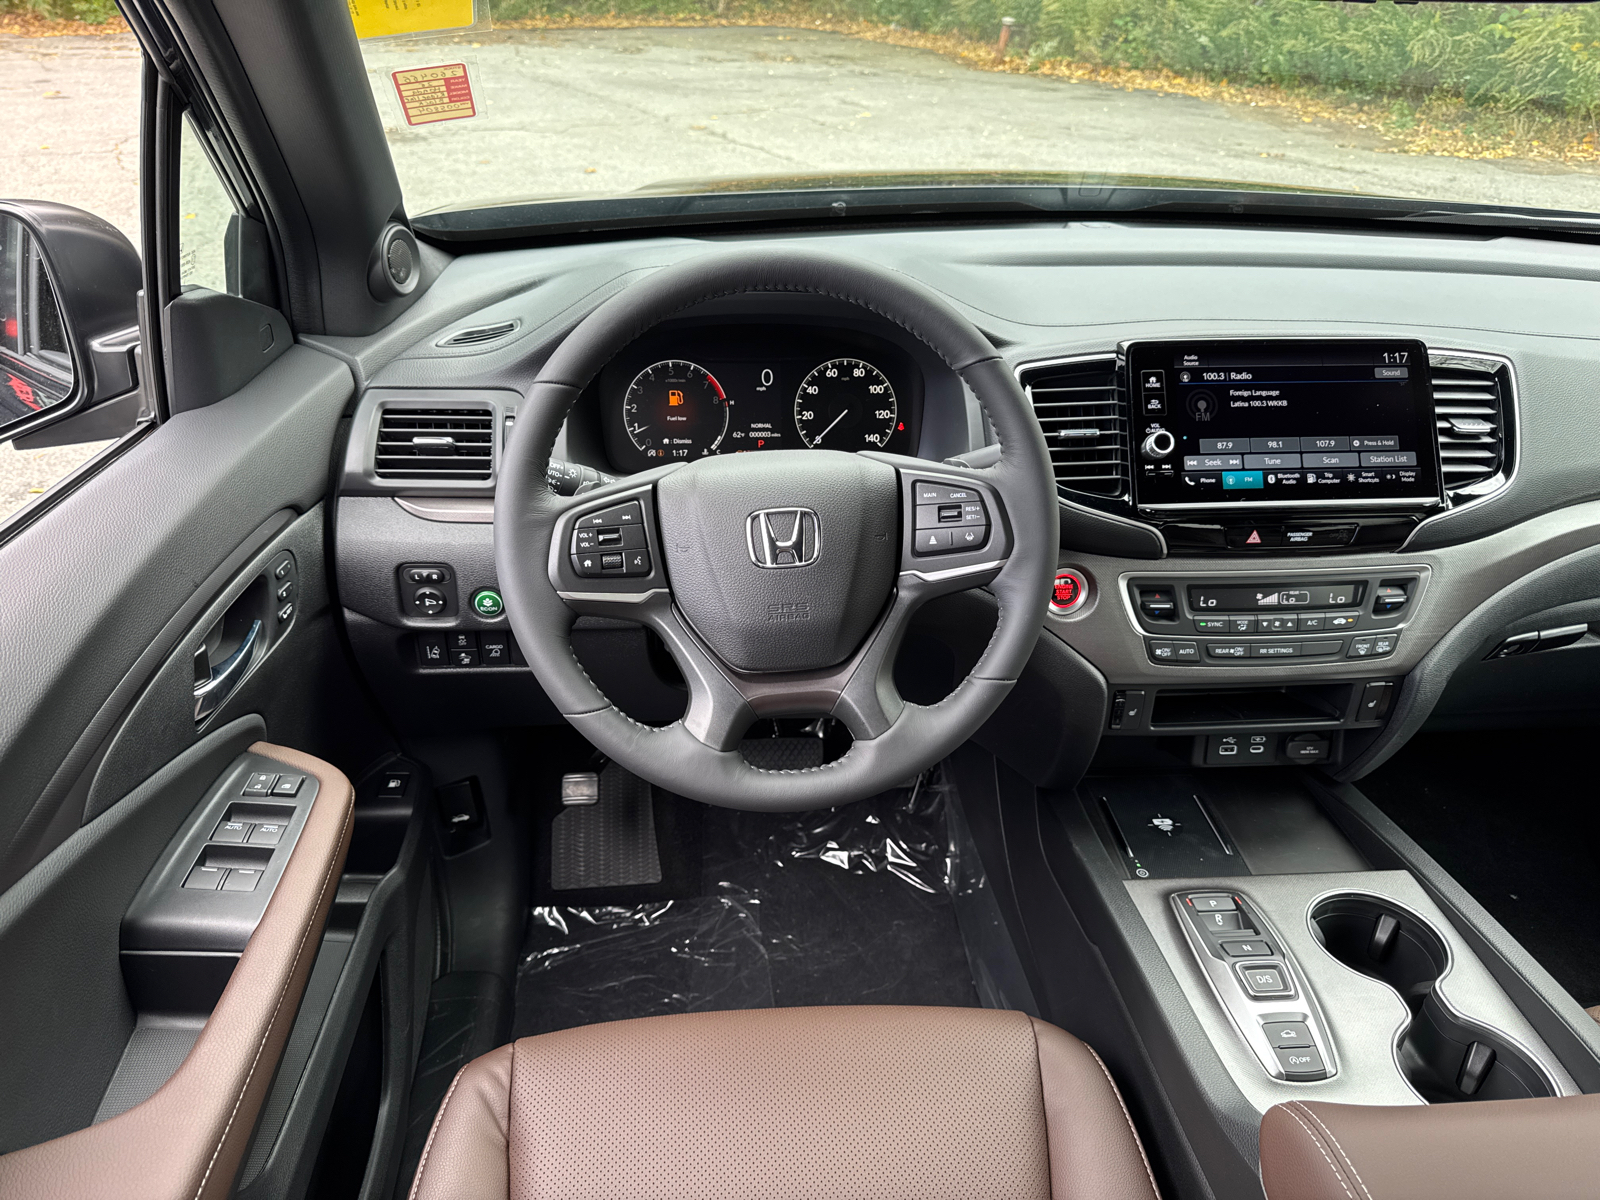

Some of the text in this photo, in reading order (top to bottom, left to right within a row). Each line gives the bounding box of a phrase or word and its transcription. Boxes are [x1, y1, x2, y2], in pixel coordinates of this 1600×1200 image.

[1383, 352, 1408, 363] 1:17
[669, 367, 674, 375] 5
[687, 370, 693, 378] 6
[826, 369, 838, 377] 60
[853, 368, 865, 377] 80
[761, 369, 773, 386] 0
[637, 386, 643, 394] 3
[806, 386, 819, 394] 40
[868, 385, 884, 394] 100
[713, 396, 718, 404] 8
[631, 404, 637, 412] 2
[802, 411, 814, 420] 20
[875, 410, 890, 419] 120
[1196, 412, 1210, 421] FM
[864, 434, 880, 442] 140
[758, 440, 765, 448] P
[547, 469, 560, 477] UTO
[768, 603, 809, 613] SRS
[767, 613, 810, 621] AIRBAG
[1256, 975, 1272, 983] D/S
